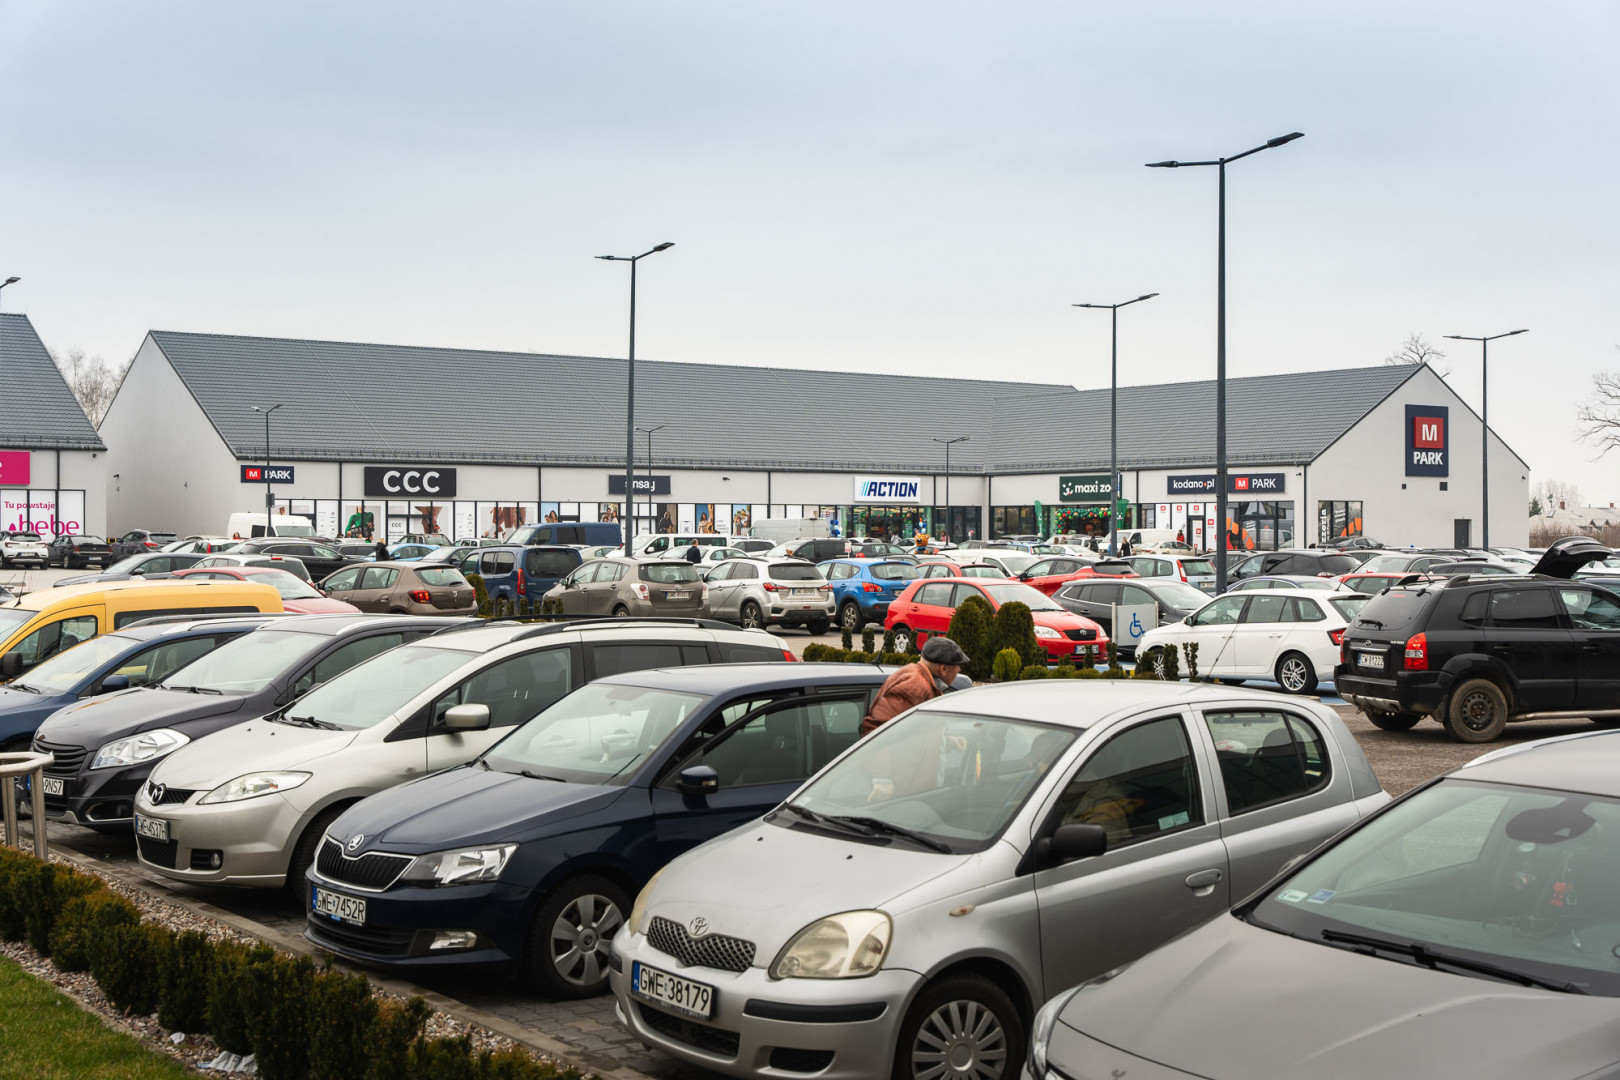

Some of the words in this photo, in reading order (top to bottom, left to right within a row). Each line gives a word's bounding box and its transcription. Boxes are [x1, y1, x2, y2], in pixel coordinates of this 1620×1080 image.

[1421, 423, 1437, 442] M
[1413, 451, 1444, 465] PARK
[249, 470, 258, 478] M
[264, 470, 291, 480] PARK
[382, 470, 440, 493] CCC
[1237, 479, 1246, 488] M
[1252, 478, 1277, 489] PARK
[867, 481, 918, 498] ACTION
[1074, 480, 1099, 493] maxi
[1099, 484, 1112, 493] zo
[4, 501, 15, 509] Tu
[16, 501, 56, 511] powstaje
[19, 513, 79, 536] hebe
[317, 890, 333, 912] GWE
[334, 895, 365, 921] 7452R
[640, 967, 664, 997] GWE
[667, 976, 710, 1012] 38179
